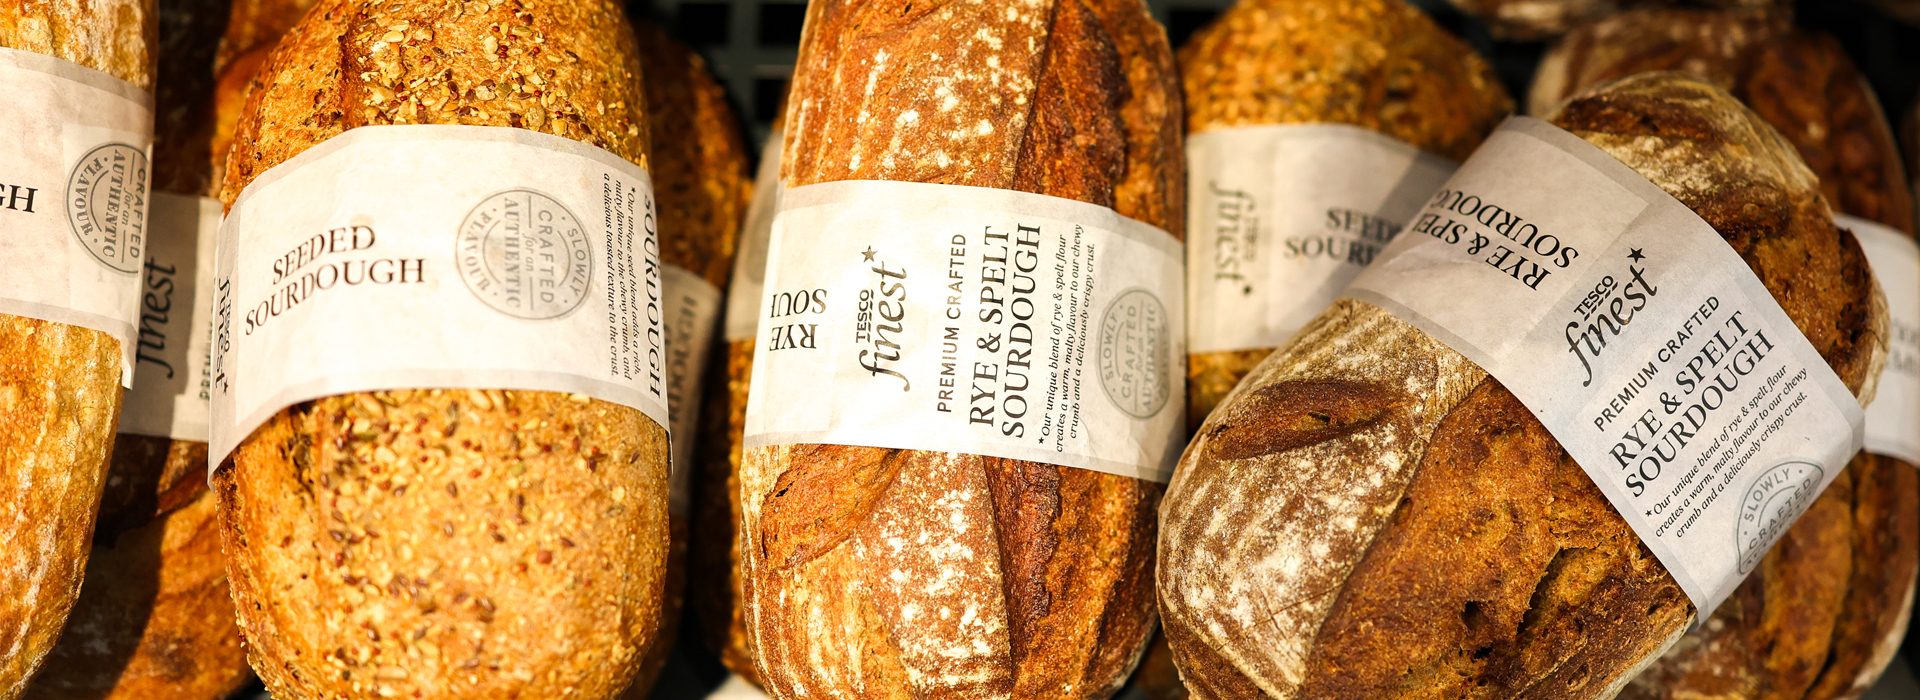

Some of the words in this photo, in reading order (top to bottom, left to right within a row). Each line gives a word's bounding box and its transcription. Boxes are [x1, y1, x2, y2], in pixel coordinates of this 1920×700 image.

[603, 172, 610, 181] a
[614, 180, 623, 208] nutty
[74, 157, 101, 236] FLAVOUR
[102, 149, 126, 258] AUTHENTIC
[123, 187, 134, 209] for
[129, 167, 146, 259] CRAFTED
[603, 182, 612, 229] delicious
[121, 210, 130, 226] an
[614, 206, 624, 248] flavour
[626, 216, 635, 253] unique
[273, 225, 376, 285] SEEDED
[465, 211, 492, 291] FLAVOUR
[504, 197, 520, 308] AUTHENTIC
[522, 233, 538, 254] for
[538, 210, 555, 303] CRAFTED
[606, 230, 615, 271] toasted
[617, 249, 624, 263] to
[1055, 234, 1067, 264] flour
[1071, 224, 1084, 257] chewy
[1087, 244, 1095, 272] crust.
[1467, 231, 1490, 255] &
[525, 256, 534, 271] an
[567, 228, 587, 296] SLOWLY
[617, 262, 625, 280] the
[627, 253, 636, 279] seed
[946, 234, 966, 320] CRAFTED
[979, 226, 1009, 325] SPELT
[1055, 263, 1065, 290] spelt
[1072, 259, 1080, 279] our
[1485, 245, 1552, 291] RYE
[245, 258, 425, 336] SOURDOUGH
[607, 270, 616, 310] texture
[619, 280, 627, 314] chewy
[630, 279, 638, 311] blend
[1053, 293, 1063, 301] &
[1070, 280, 1078, 291] to
[1083, 274, 1095, 308] crispy
[1573, 275, 1613, 316] TESCO
[608, 311, 616, 324] to
[632, 311, 640, 339] adds
[856, 289, 870, 343] TESCO
[859, 261, 910, 392] finest
[1001, 223, 1040, 438] SOURDOUGH
[1051, 321, 1063, 335] of
[1053, 303, 1064, 322] rye
[1066, 293, 1077, 334] flavour
[1565, 264, 1658, 387] finest
[609, 325, 618, 344] the
[633, 340, 638, 348] a
[769, 323, 818, 351] RYE
[976, 333, 1001, 353] &
[1048, 337, 1060, 369] blend
[1064, 333, 1075, 364] malty
[1075, 309, 1089, 366] deliciously
[1103, 312, 1117, 381] SLOWLY
[1121, 306, 1136, 399] CRAFTED
[610, 345, 619, 376] crust.
[623, 356, 632, 381] and
[937, 327, 960, 412] PREMIUM
[1075, 368, 1081, 376] a
[1593, 361, 1659, 432] PREMIUM
[1657, 296, 1720, 363] CRAFTED
[969, 362, 998, 427] RYE
[1046, 371, 1058, 411] unique
[1062, 367, 1071, 400] warm,
[1072, 378, 1080, 401] and
[1609, 408, 1663, 470] RYE
[1659, 391, 1683, 415] &
[1676, 310, 1748, 395] SPELT
[1061, 403, 1068, 411] a
[1070, 402, 1080, 439] crumb
[1625, 329, 1775, 498] SOURDOUGH
[1056, 413, 1066, 452] creates
[1671, 465, 1699, 497] unique
[1697, 437, 1721, 467] blend
[1720, 426, 1730, 442] of
[1728, 415, 1742, 432] rye
[1740, 406, 1749, 417] &
[1748, 385, 1768, 409] spelt
[1766, 365, 1787, 392] flour
[1655, 505, 1684, 537] creates
[1683, 498, 1690, 507] a
[1689, 472, 1715, 500] warm,
[1712, 447, 1735, 473] malty
[1732, 417, 1758, 453] flavour
[1758, 409, 1769, 420] to
[1768, 392, 1782, 411] our
[1783, 367, 1807, 395] chewy
[1676, 507, 1702, 538] crumb
[1701, 488, 1718, 510] and
[1717, 483, 1724, 492] a
[1723, 439, 1761, 485] deliciously
[1760, 414, 1784, 442] crispy
[1784, 392, 1808, 417] crust.
[1744, 468, 1790, 522] SLOWLY
[1748, 478, 1811, 550] CRAFTED
